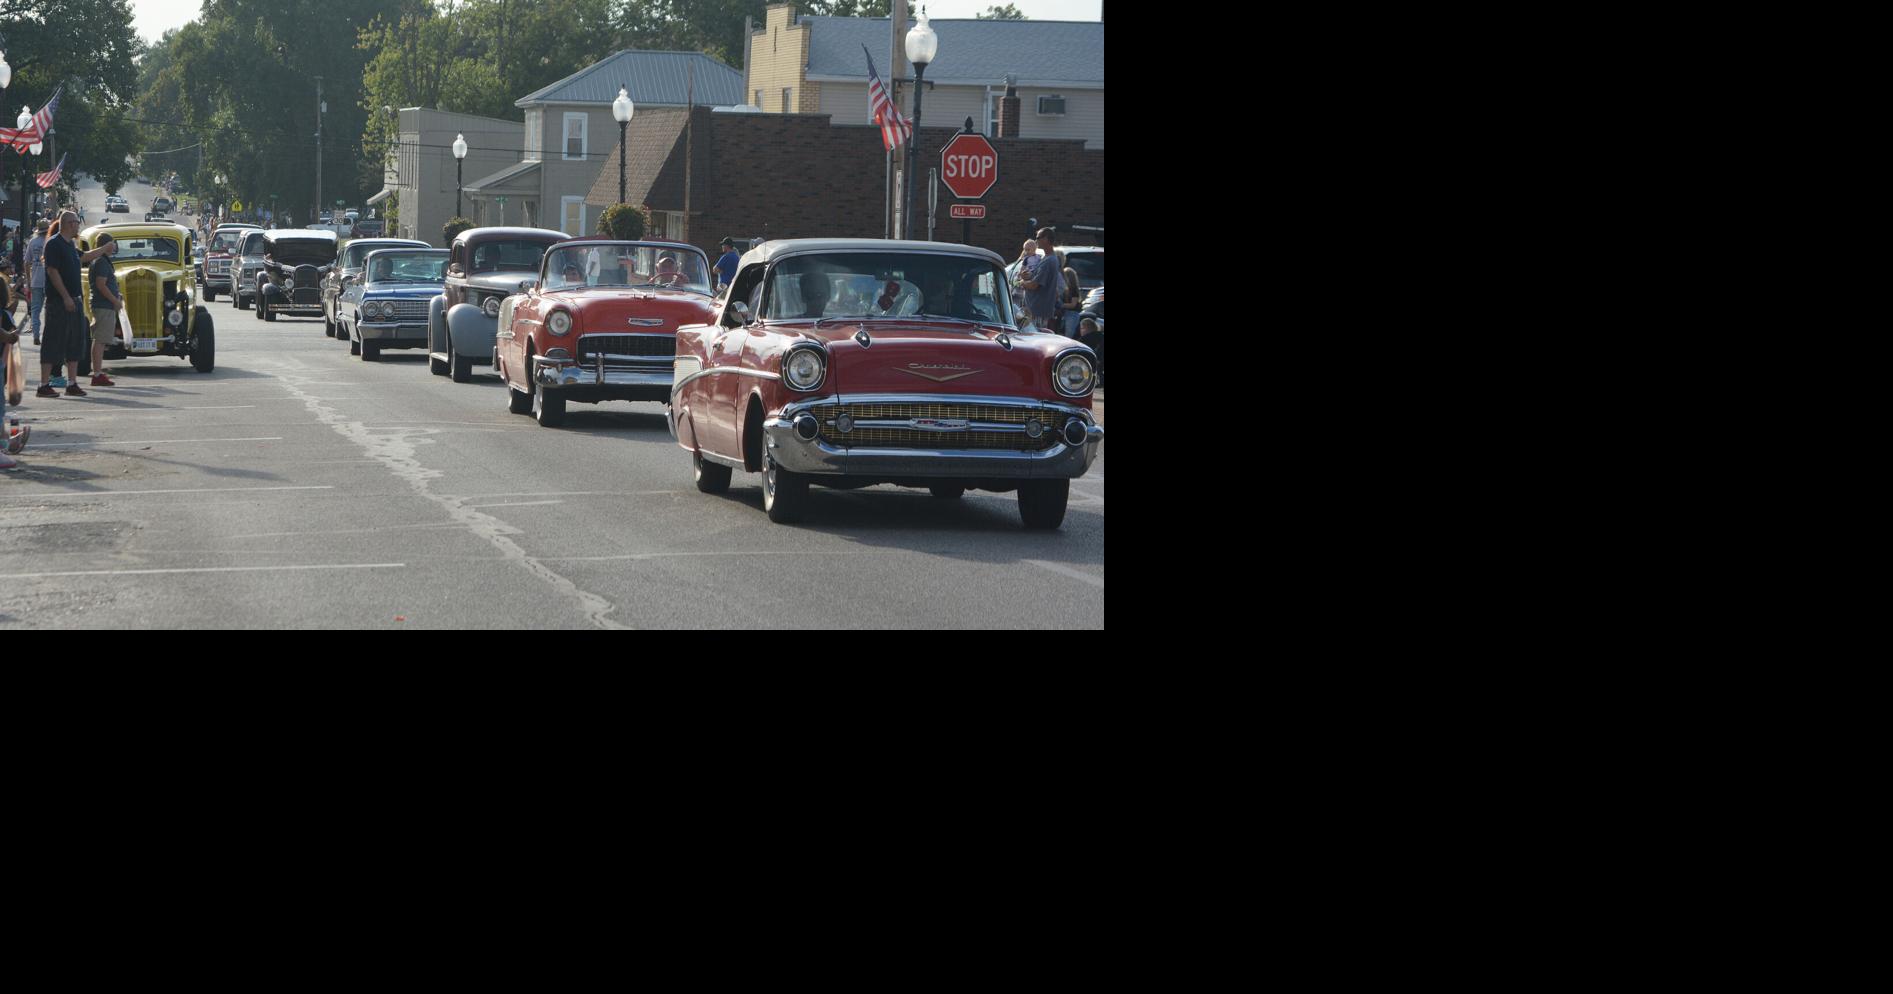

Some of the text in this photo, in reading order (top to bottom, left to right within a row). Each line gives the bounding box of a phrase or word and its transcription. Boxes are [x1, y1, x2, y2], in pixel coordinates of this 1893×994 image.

[946, 154, 993, 178] STOP
[953, 207, 983, 216] ALL WAY
